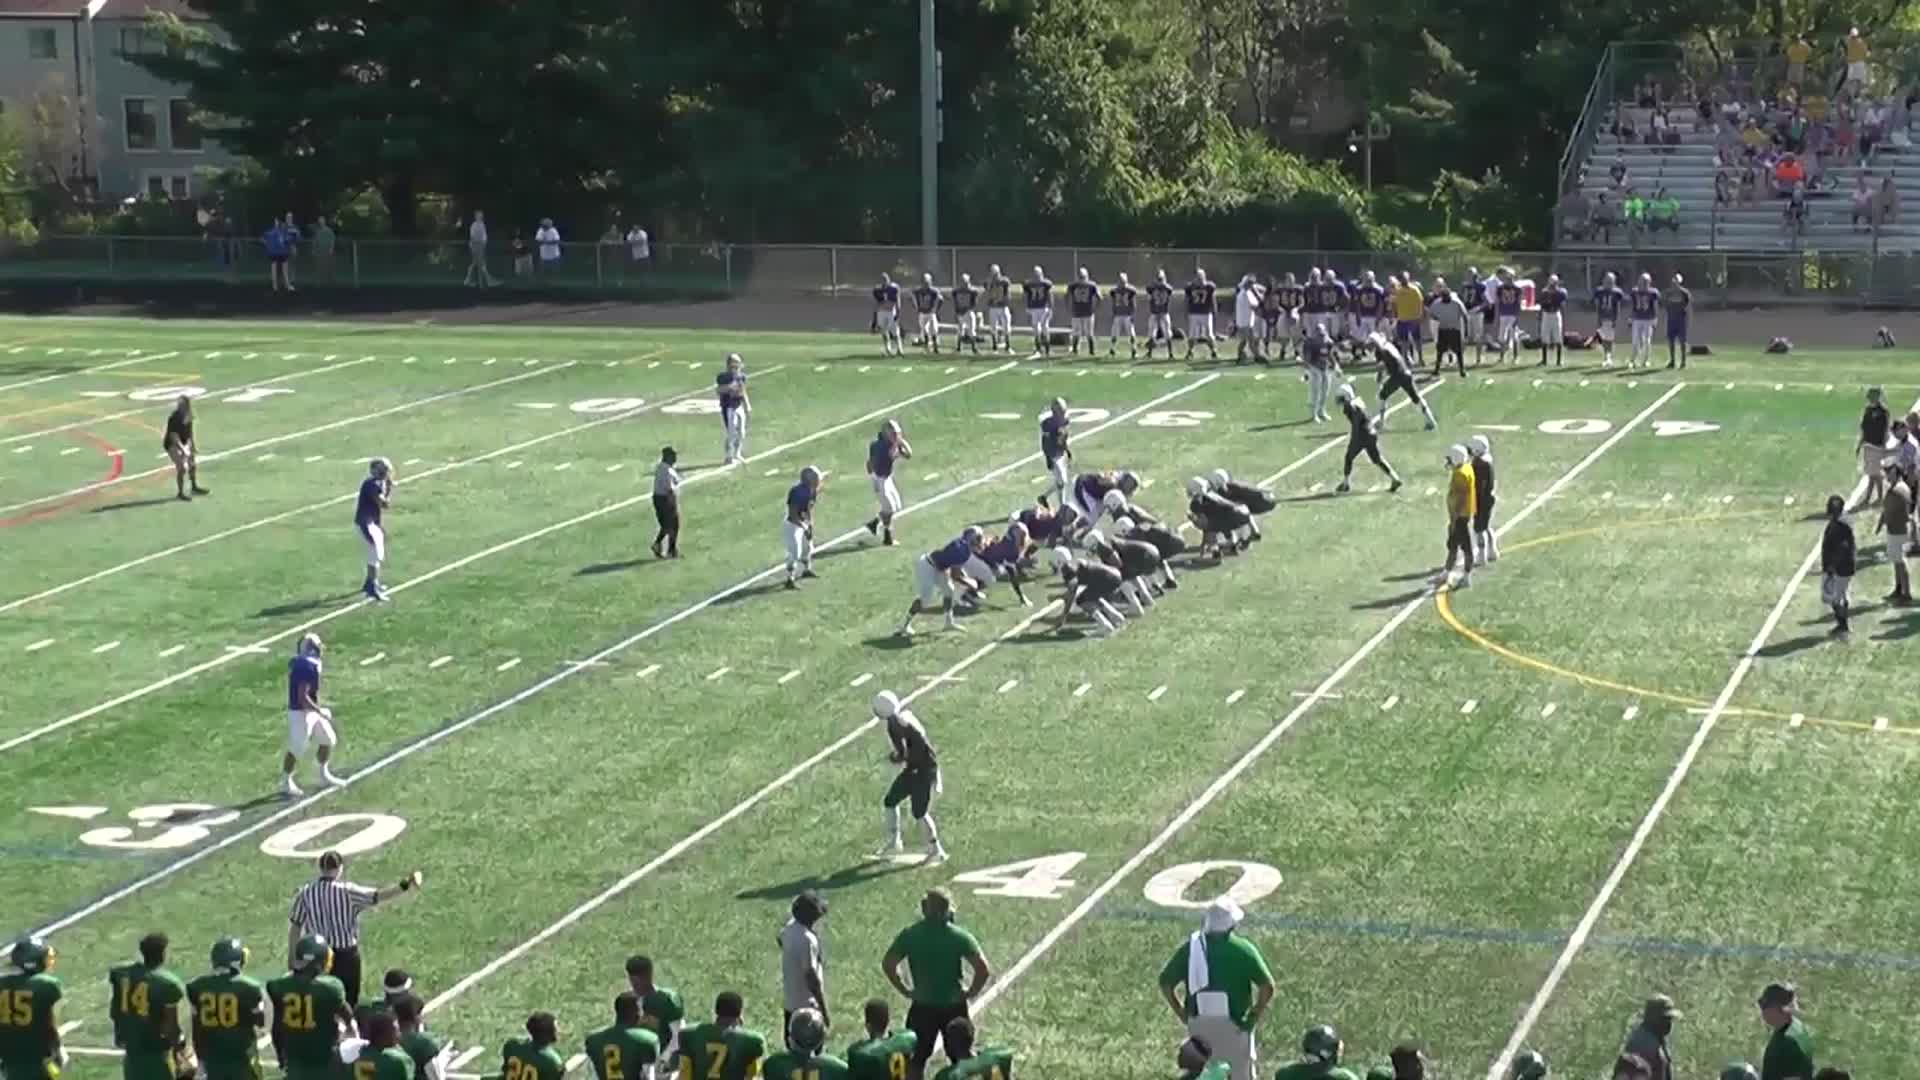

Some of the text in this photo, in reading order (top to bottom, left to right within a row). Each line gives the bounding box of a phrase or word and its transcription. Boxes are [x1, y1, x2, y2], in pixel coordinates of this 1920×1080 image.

[1537, 418, 1721, 437] 40
[80, 803, 407, 857] 30
[951, 851, 1283, 907] 40
[121, 976, 150, 1017] 14
[282, 992, 317, 1029] 21
[603, 1043, 625, 1080] 2
[705, 1042, 729, 1080] 7
